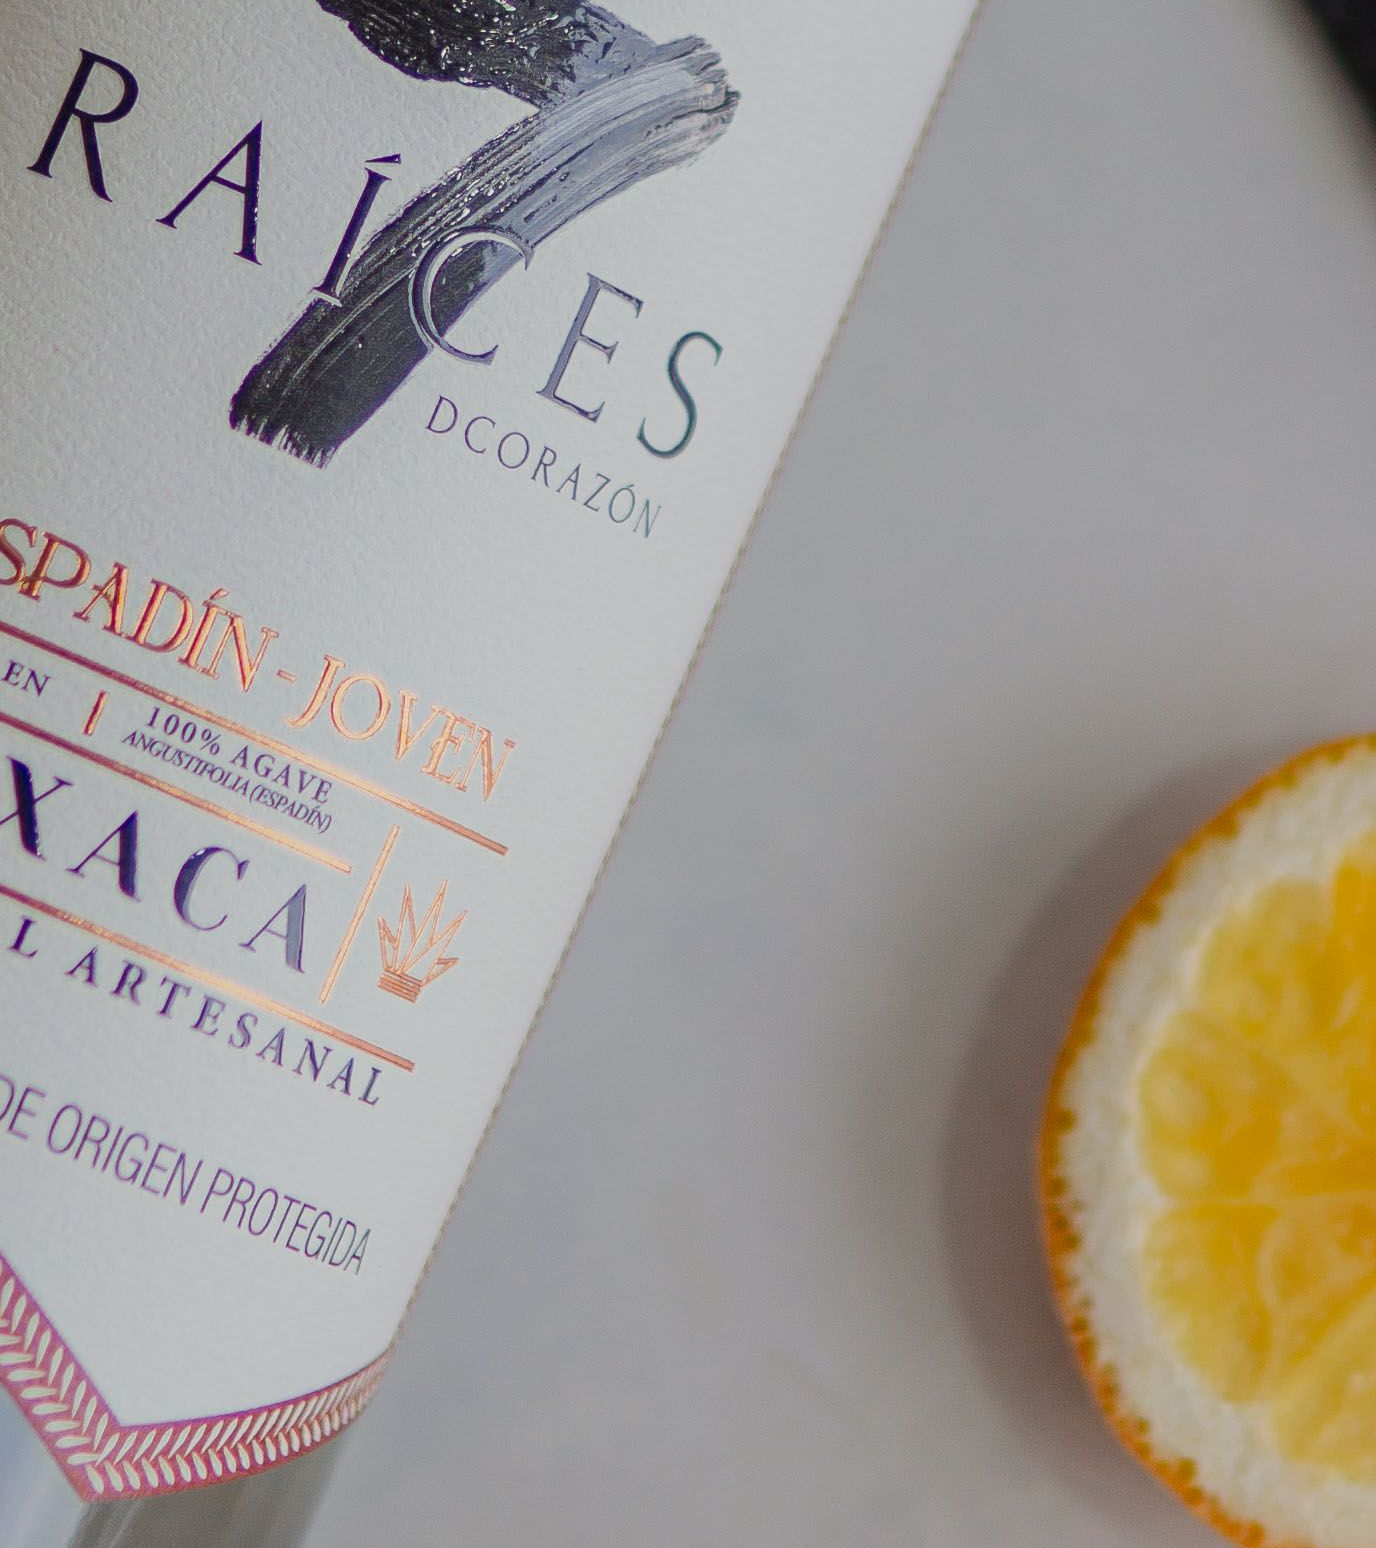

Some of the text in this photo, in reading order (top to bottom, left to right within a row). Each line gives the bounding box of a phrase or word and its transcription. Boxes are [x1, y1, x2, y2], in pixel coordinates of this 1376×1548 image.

[26, 47, 723, 461] RAÍCES
[426, 394, 662, 540] DCORAZÓN
[3, 659, 52, 697] EN
[286, 654, 518, 803] JOVEN
[121, 730, 251, 797] ANGUSTIFOLIA
[146, 706, 333, 805] 100% AGAVE
[64, 945, 383, 1107] ARTESANAL
[46, 1104, 205, 1207] ORIGEN
[201, 1166, 374, 1277] PROTEGIDA
